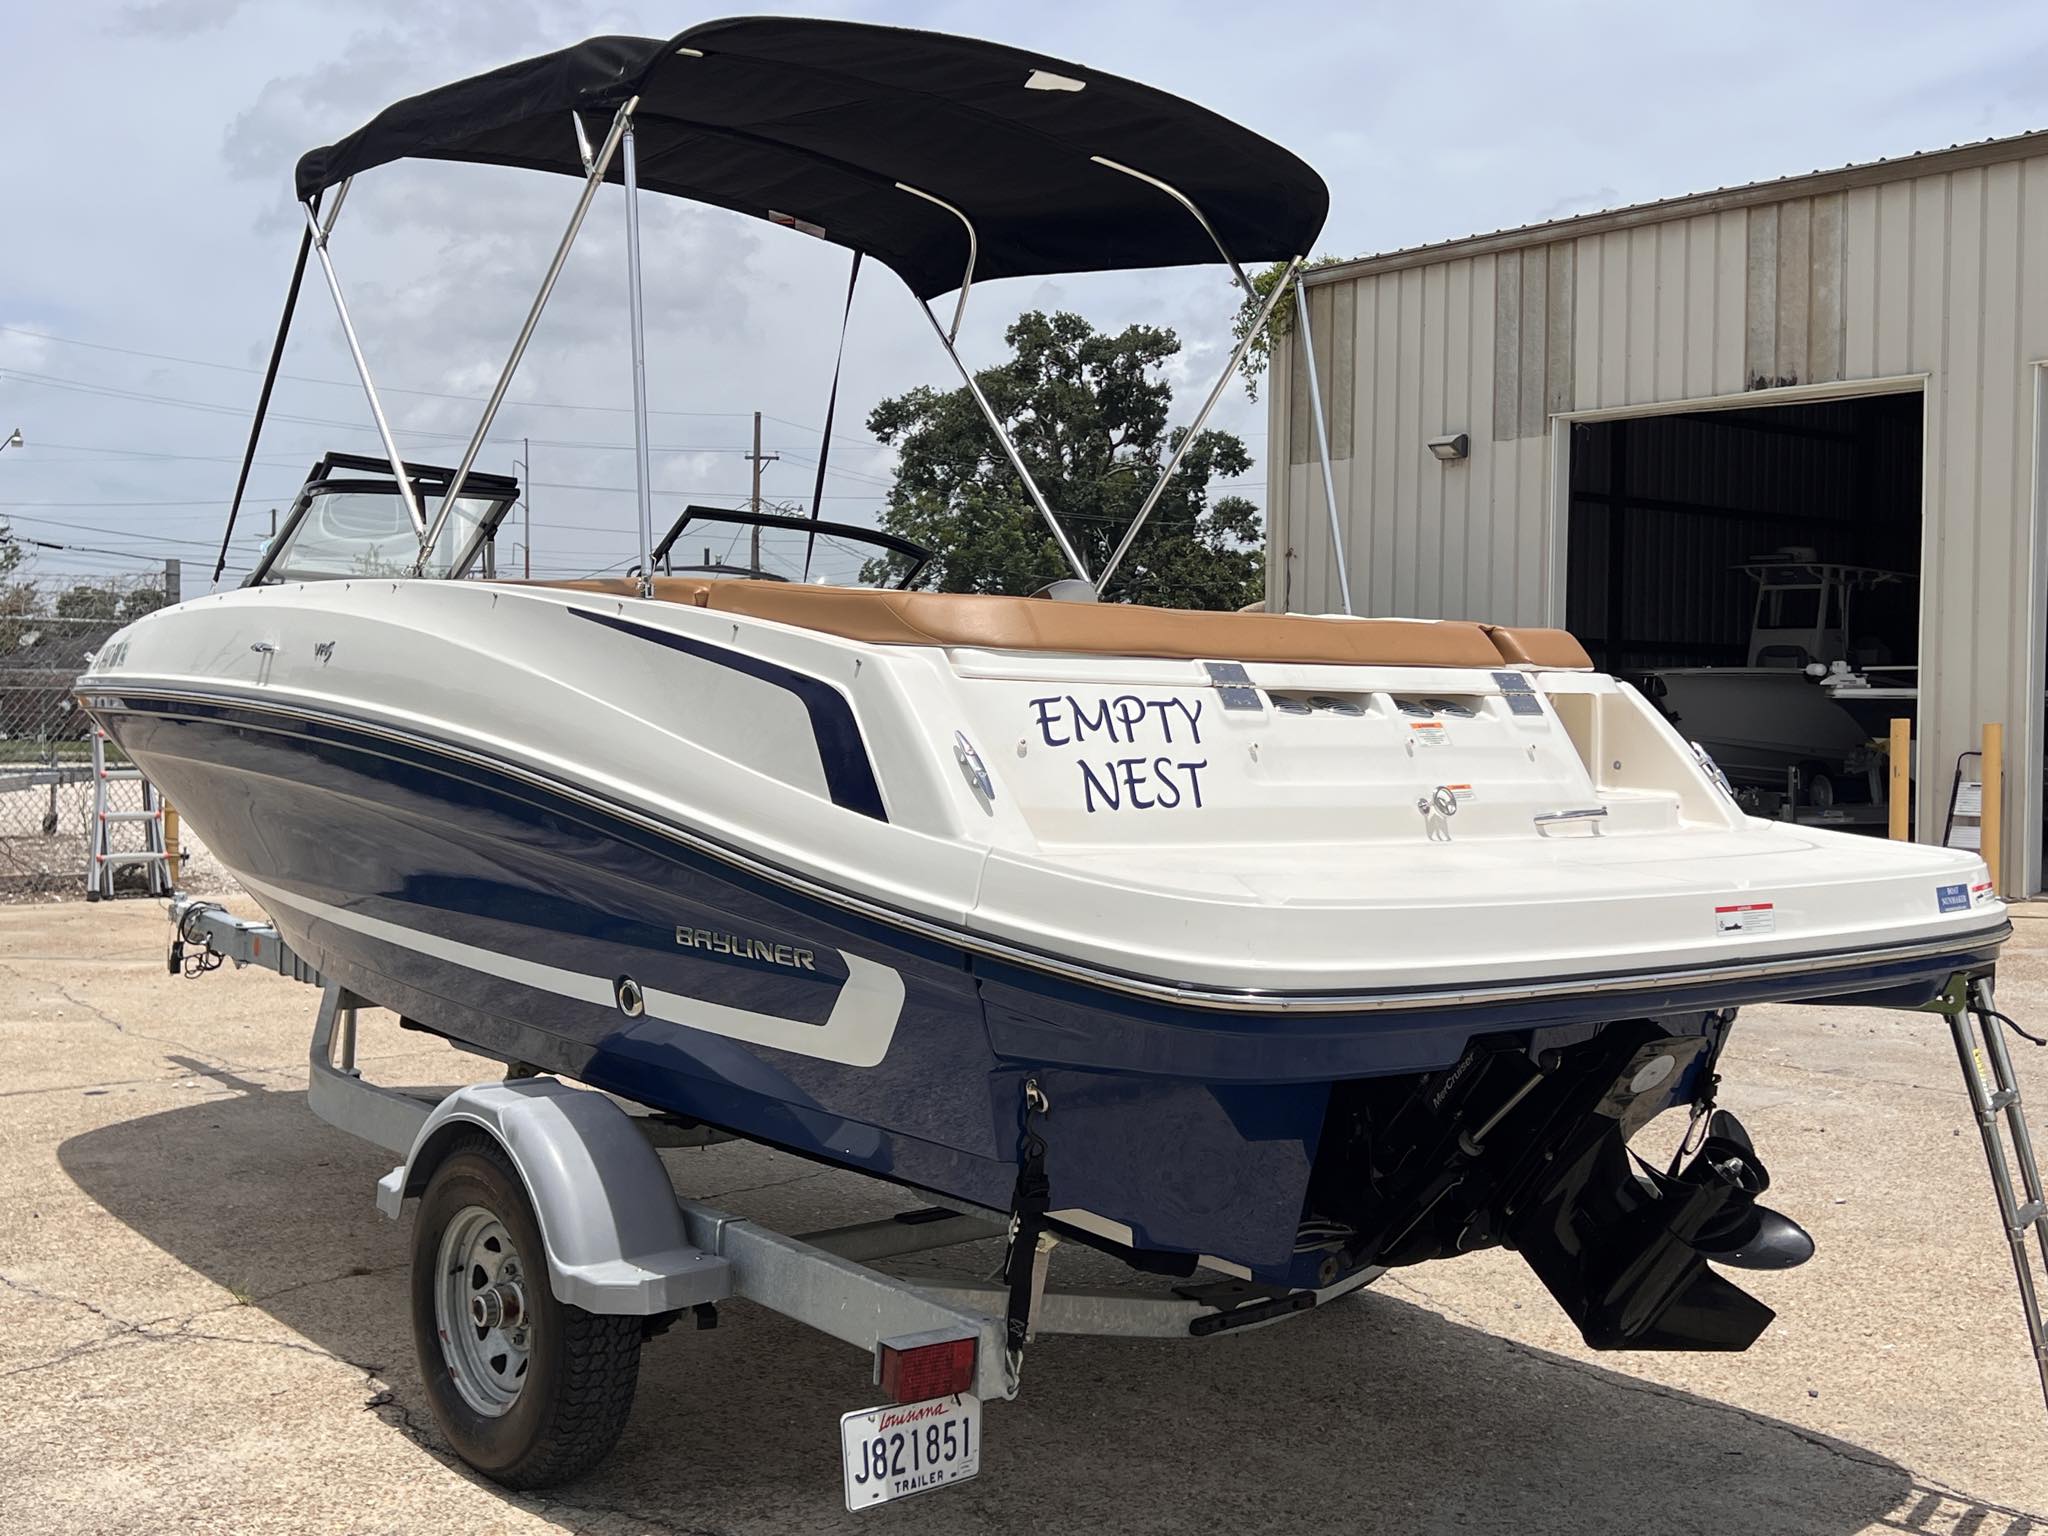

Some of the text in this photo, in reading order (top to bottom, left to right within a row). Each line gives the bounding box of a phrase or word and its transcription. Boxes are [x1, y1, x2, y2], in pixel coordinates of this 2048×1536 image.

[1029, 695, 1202, 747] EMPTY
[1076, 757, 1208, 813] NEST
[676, 925, 816, 971] BAYLINER
[1432, 1052, 1475, 1109] MerCruiser
[878, 1403, 949, 1432] Louisiana
[855, 1417, 969, 1484] J821851
[894, 1470, 943, 1493] TRAILER
